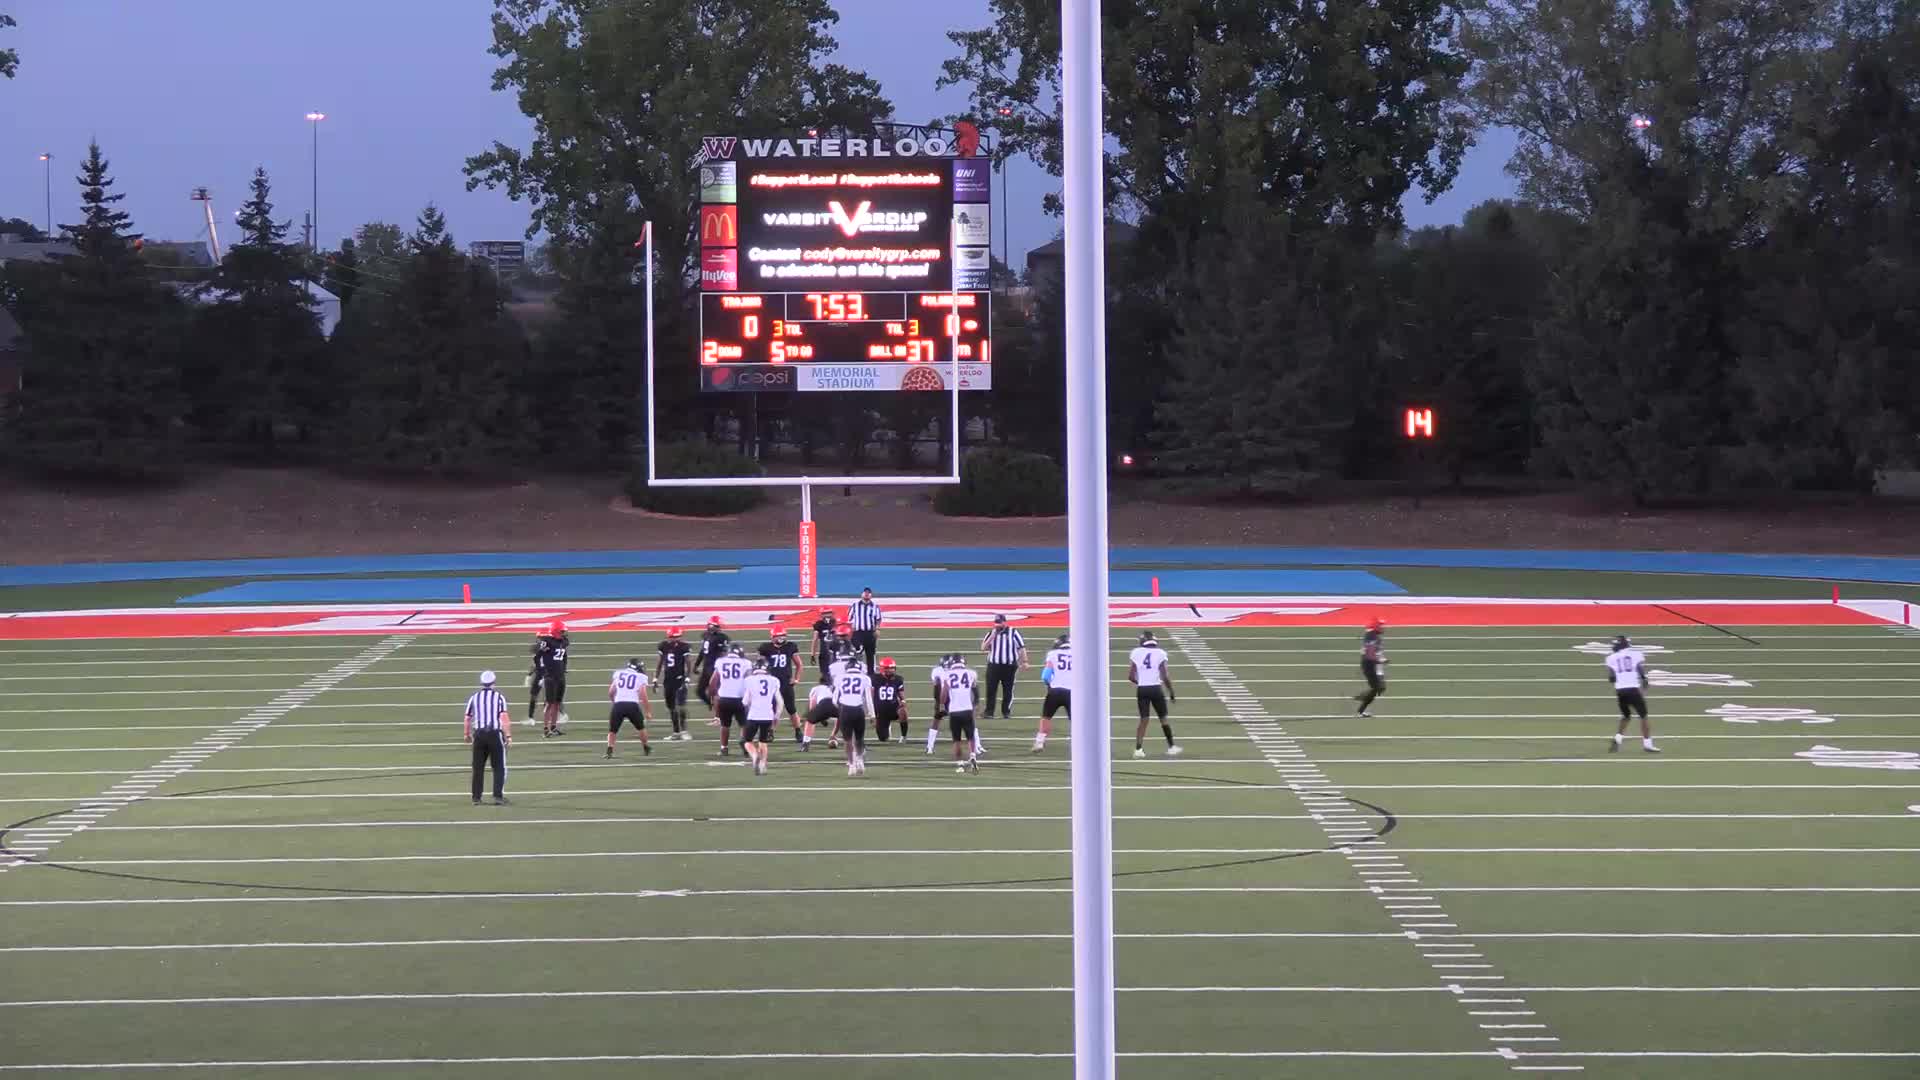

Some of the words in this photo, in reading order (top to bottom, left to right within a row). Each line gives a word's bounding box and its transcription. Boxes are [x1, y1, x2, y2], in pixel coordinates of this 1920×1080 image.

[742, 138, 947, 157] WATERLOO
[956, 169, 976, 178] UNI
[760, 264, 776, 277] to
[838, 266, 857, 277] on
[858, 264, 885, 277] this
[743, 315, 759, 338] 0
[773, 320, 783, 336] 3
[908, 319, 919, 336] 3
[703, 340, 718, 363] 2
[770, 340, 785, 363] 5
[785, 345, 800, 357] TO
[907, 340, 934, 362] 37
[980, 339, 988, 361] 1
[738, 370, 789, 386] pepsi
[811, 367, 880, 378] MEMORIAL
[817, 379, 875, 389] STADIUM
[1407, 408, 1432, 437] 14
[802, 525, 811, 595] TROJANS
[667, 653, 675, 667] 5
[771, 654, 788, 668] 78
[1142, 652, 1153, 670] 4
[1616, 656, 1633, 673] 10
[722, 663, 741, 679] 56
[618, 673, 637, 690] 50
[760, 679, 769, 696] 3
[842, 677, 862, 694] 22
[949, 672, 970, 689] 24
[879, 686, 894, 700] 69
